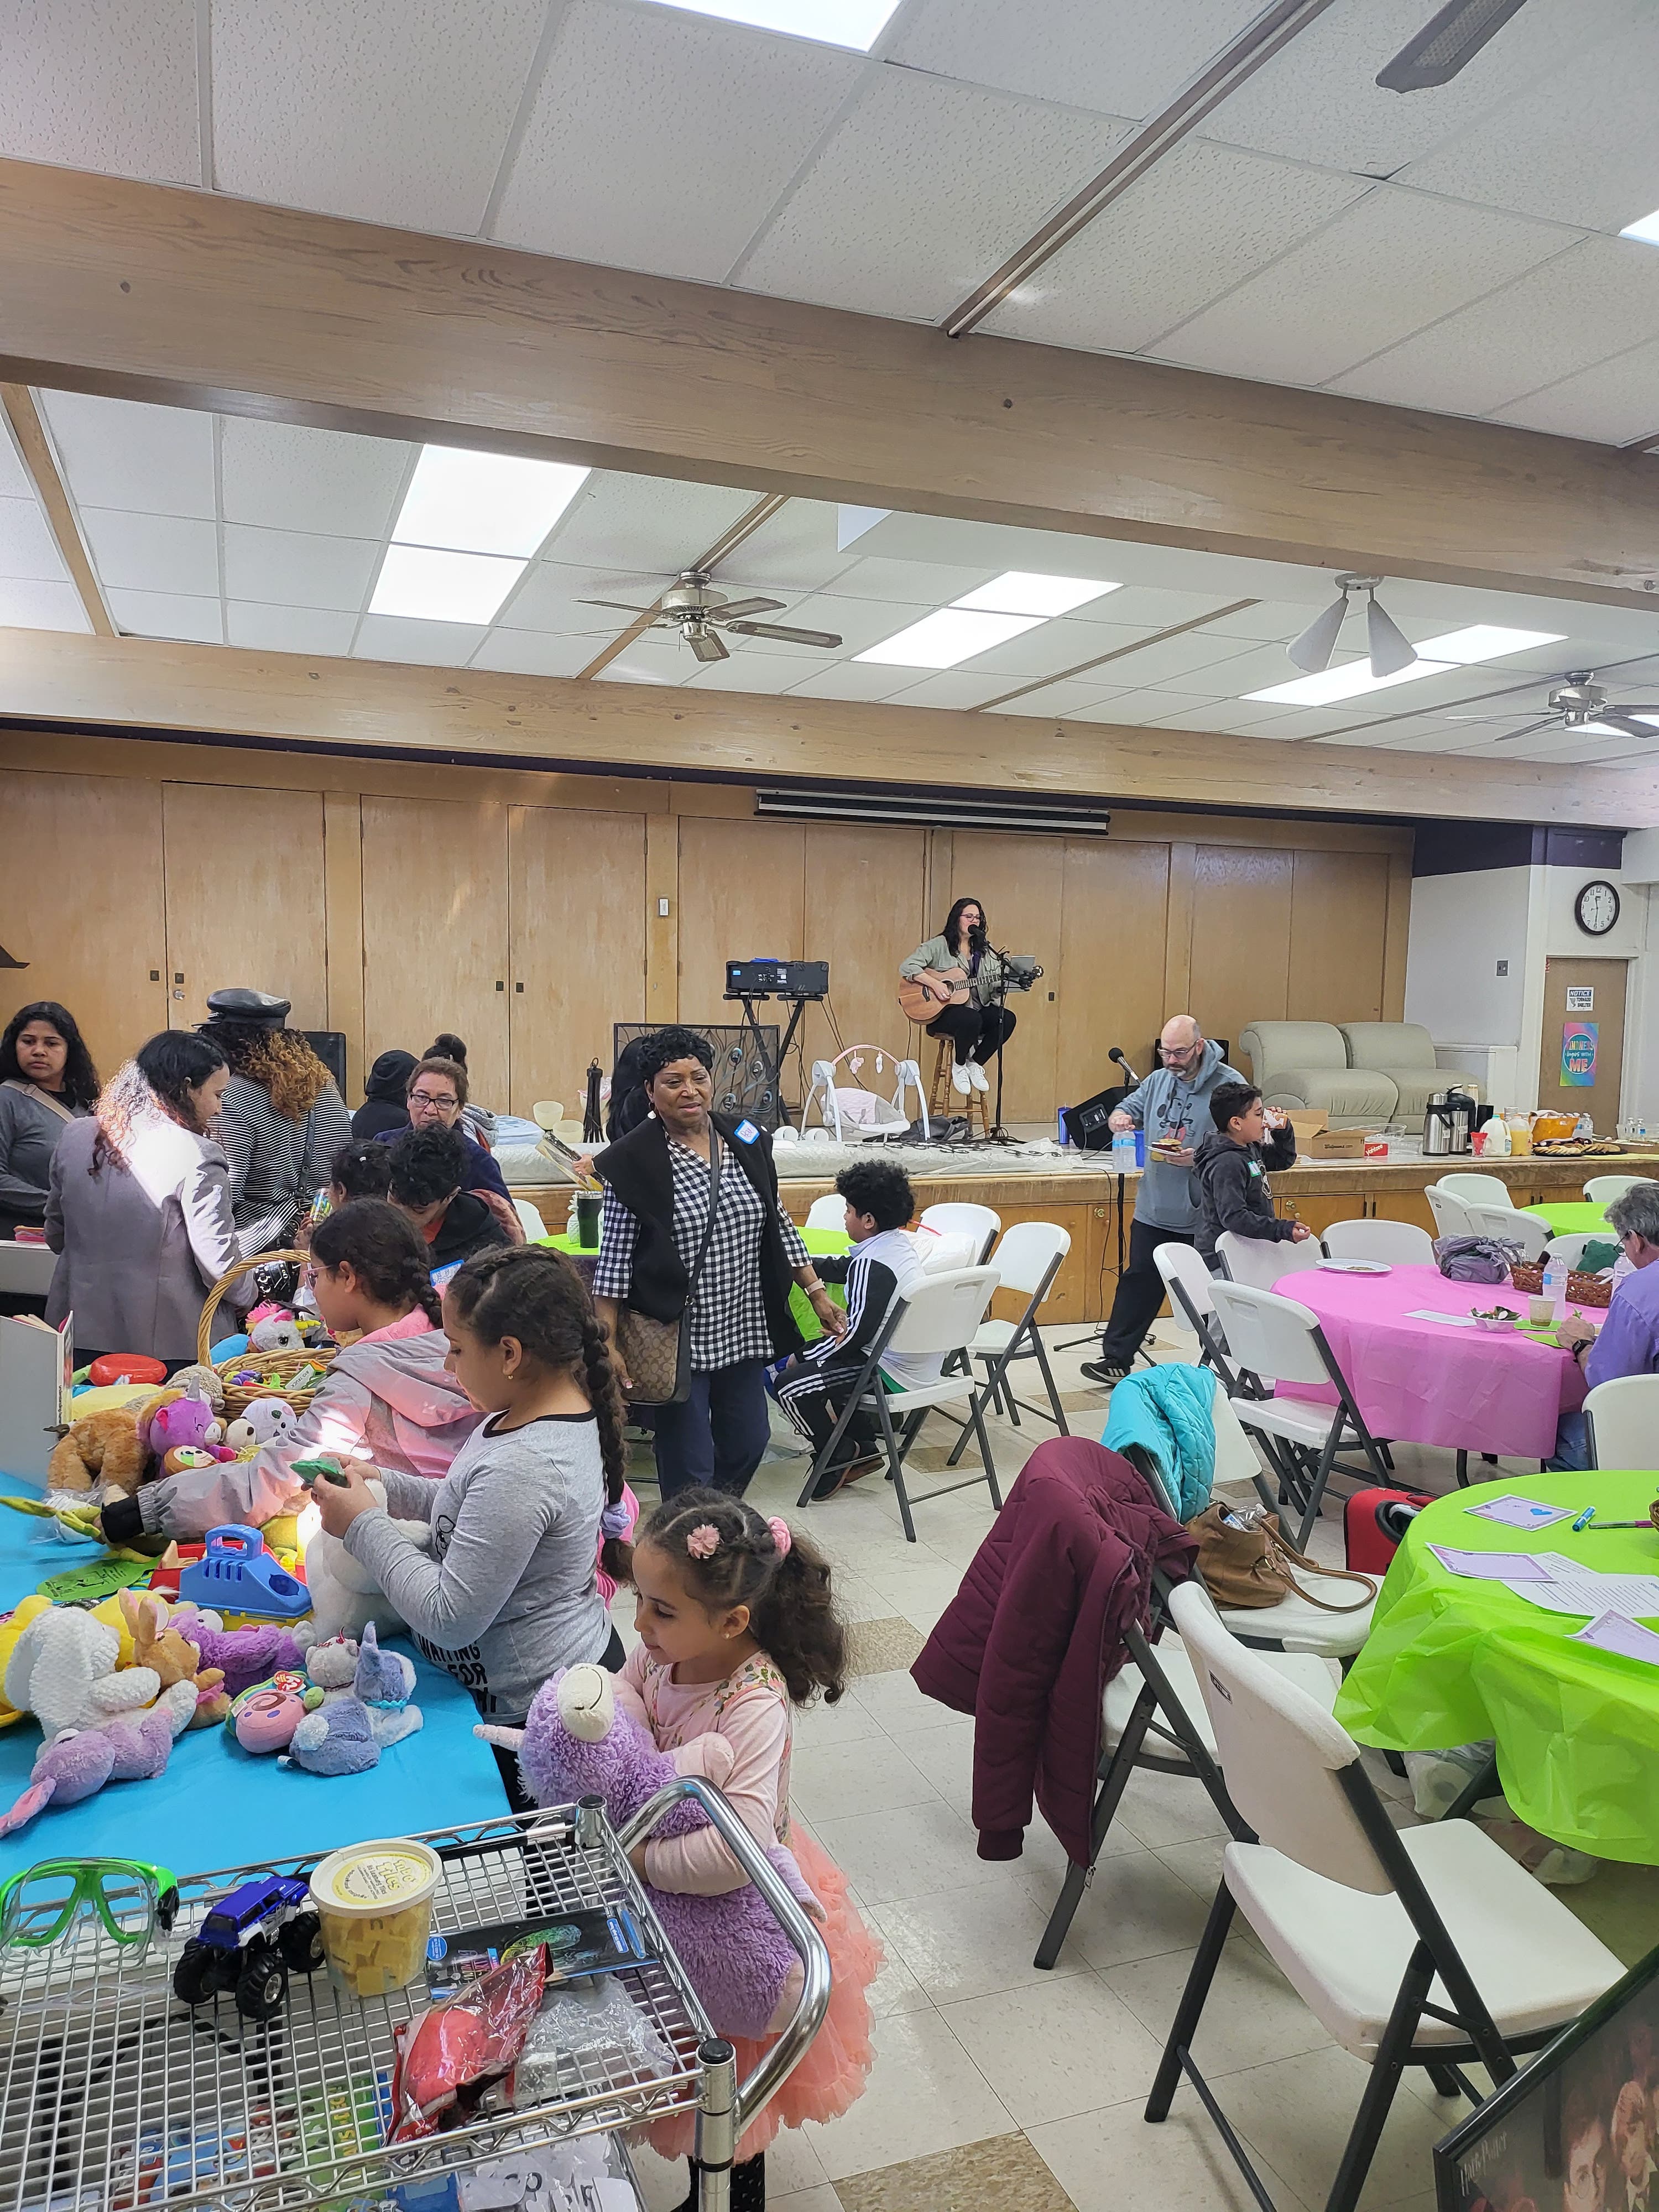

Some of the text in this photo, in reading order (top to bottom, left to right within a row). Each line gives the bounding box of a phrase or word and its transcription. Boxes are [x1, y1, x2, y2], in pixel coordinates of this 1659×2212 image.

[1569, 1058, 1588, 1072] ME
[1365, 1144, 1383, 1156] Yahtzee
[290, 1376, 303, 1388] TRUCK
[447, 1662, 488, 1686] FOR
[376, 1861, 401, 1891] Tiles
